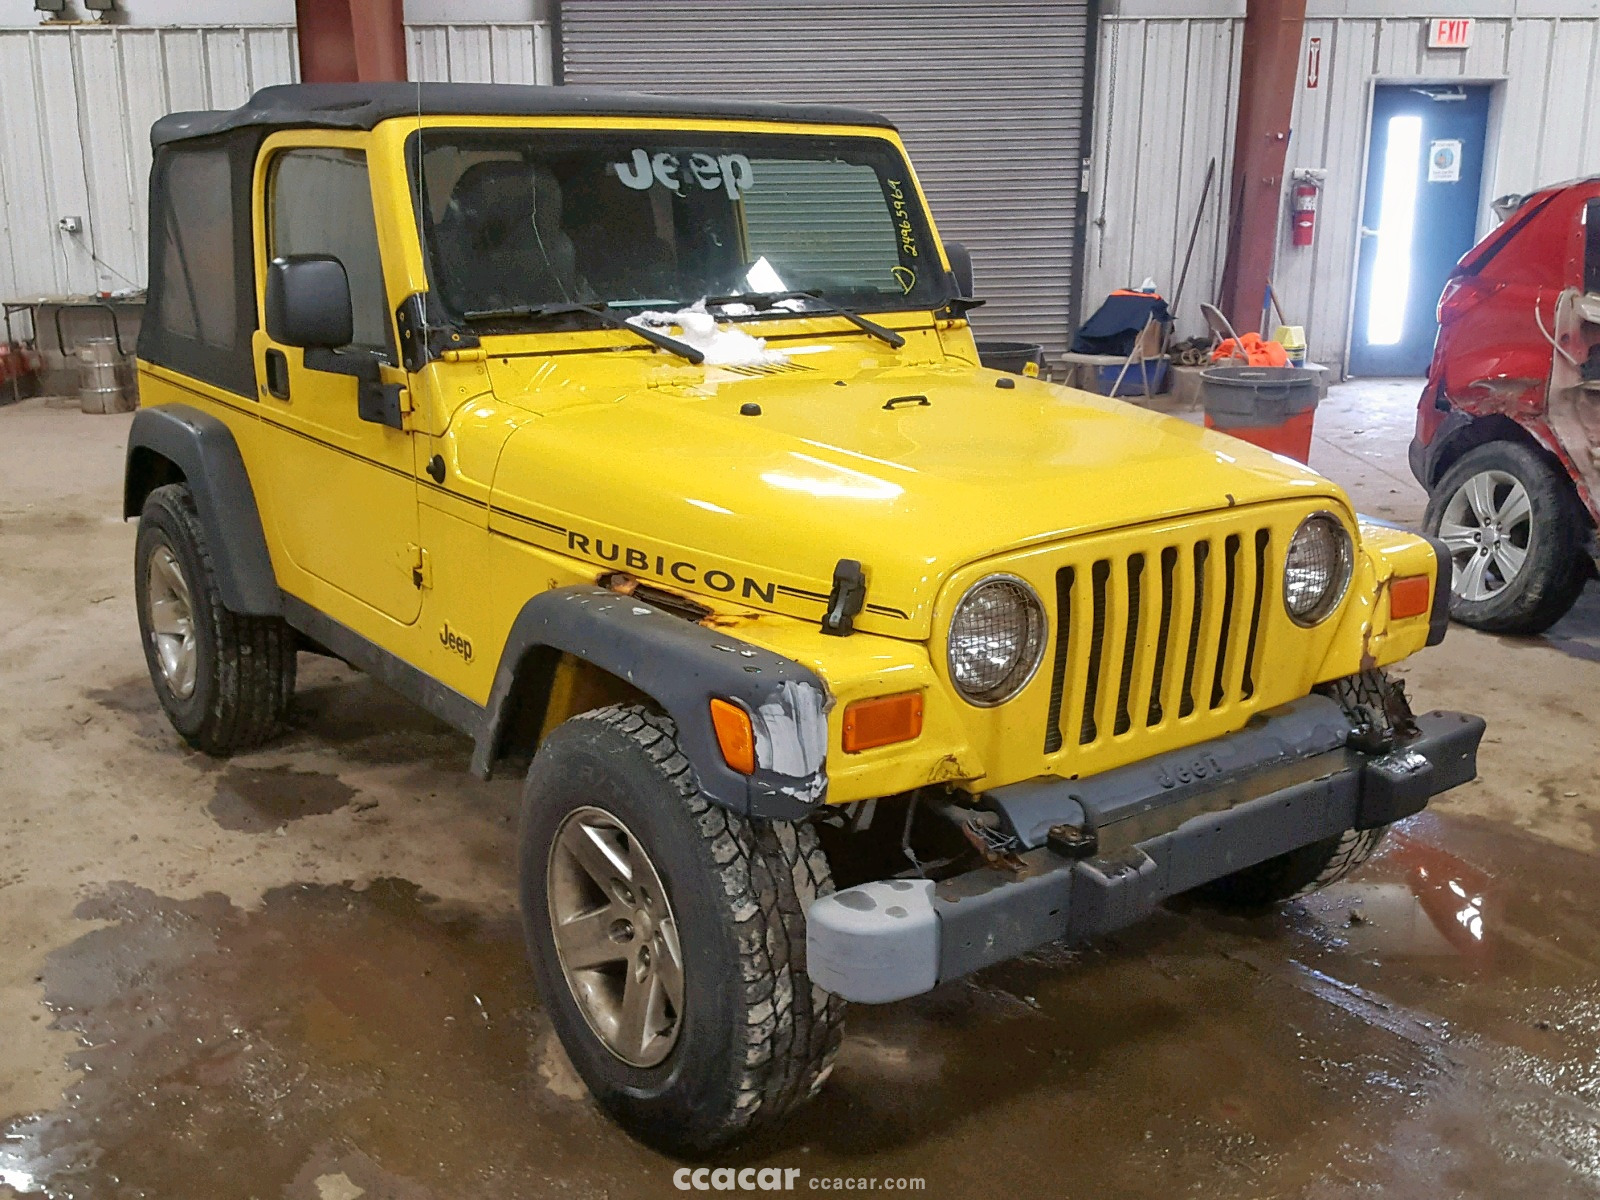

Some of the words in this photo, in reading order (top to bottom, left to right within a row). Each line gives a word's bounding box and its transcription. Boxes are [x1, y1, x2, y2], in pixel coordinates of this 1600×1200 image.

[1437, 20, 1469, 44] EXIT
[614, 148, 753, 199] Jeep
[567, 531, 775, 604] RUBICON
[439, 623, 472, 661] Jeep
